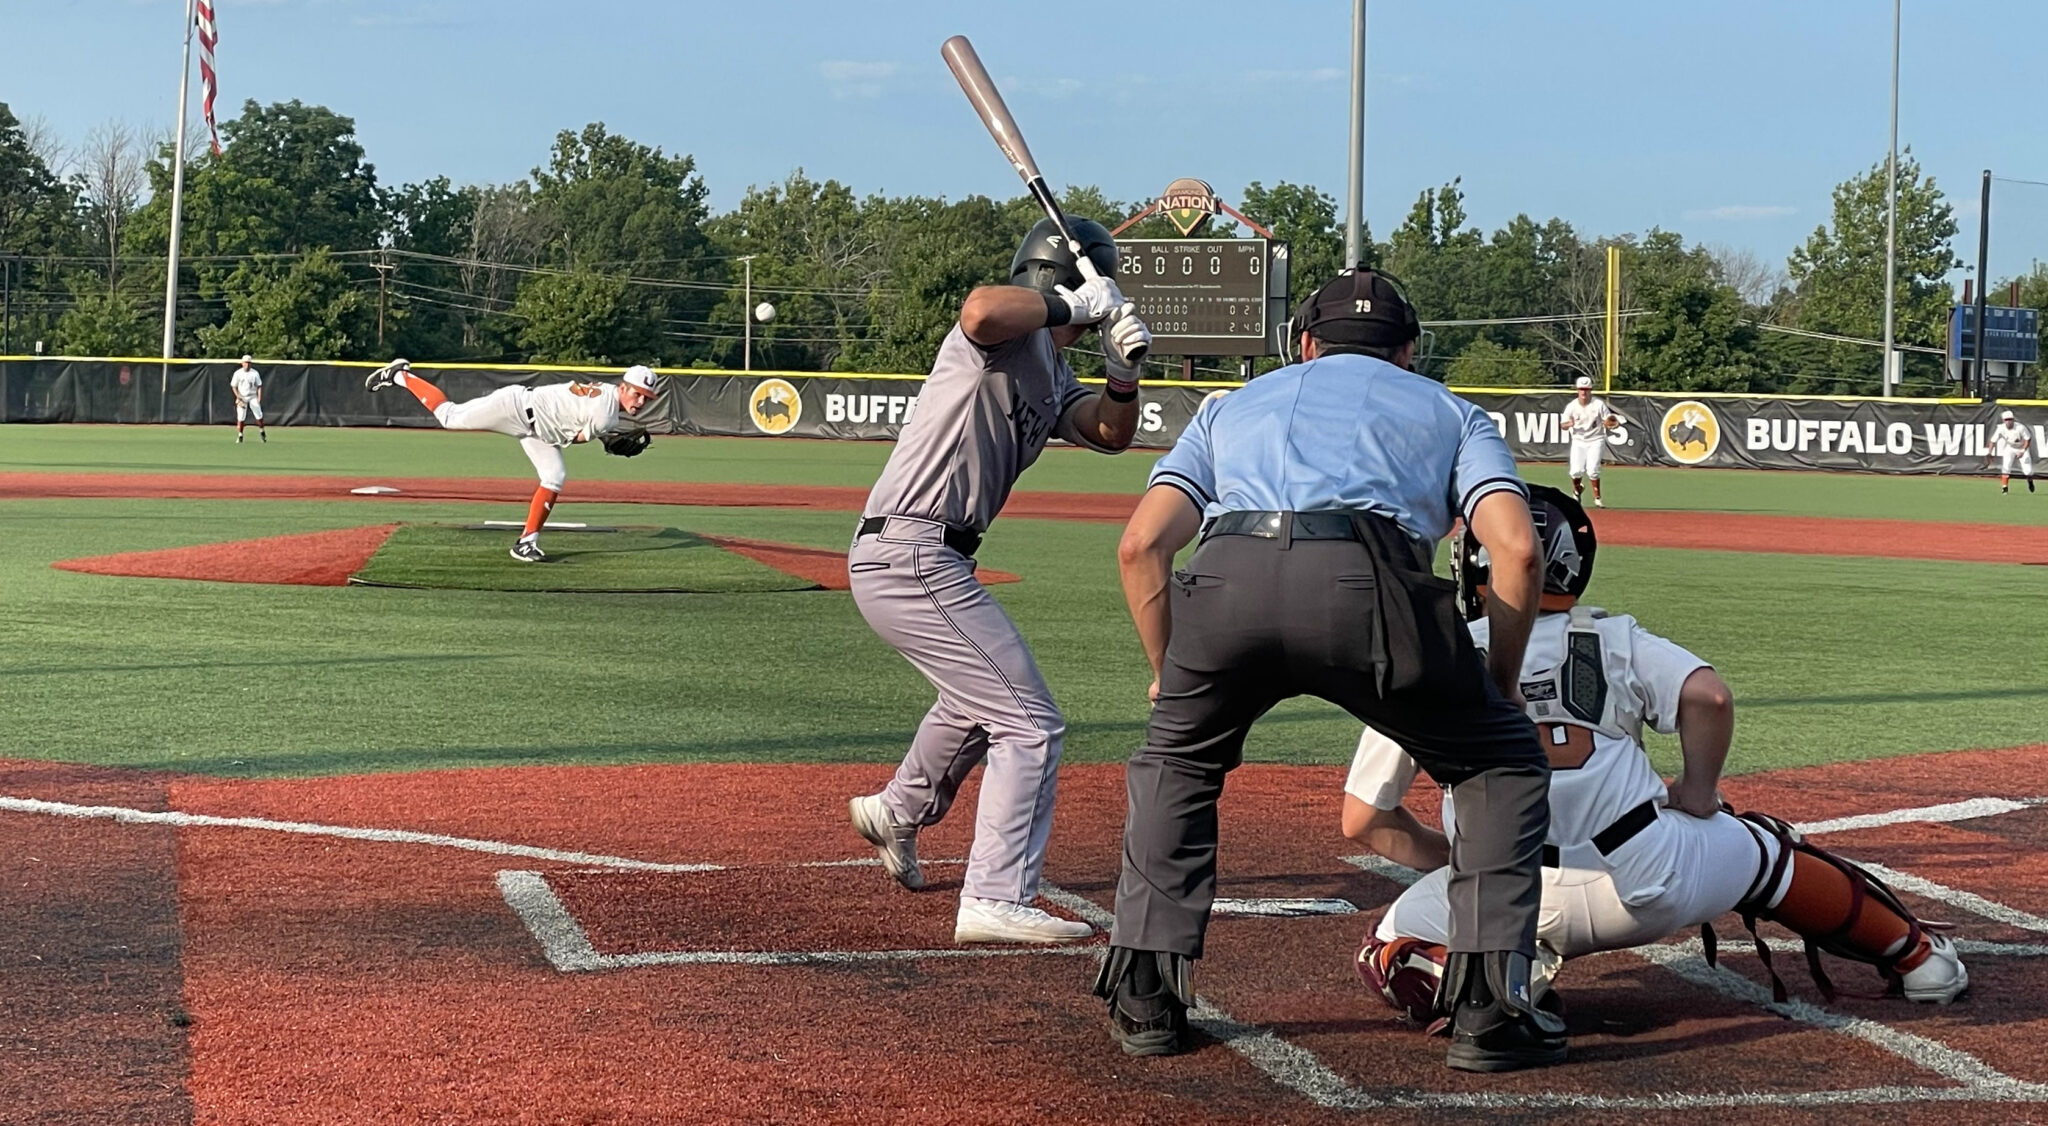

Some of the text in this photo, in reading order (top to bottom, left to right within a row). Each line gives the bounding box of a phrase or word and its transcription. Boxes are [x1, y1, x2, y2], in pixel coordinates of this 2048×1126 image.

[1158, 196, 1215, 212] NATION
[1151, 246, 1169, 254] BALL
[1174, 246, 1200, 254] STRIKE
[1207, 246, 1223, 254] OUT
[1155, 256, 1165, 275] 0
[1182, 256, 1192, 275] 0
[1210, 256, 1221, 275] 0
[1250, 256, 1260, 275] 0
[1355, 299, 1371, 313] 79
[825, 394, 919, 424] BUFF
[1746, 418, 1913, 455] BUFFALO
[1923, 423, 2006, 457] WIL
